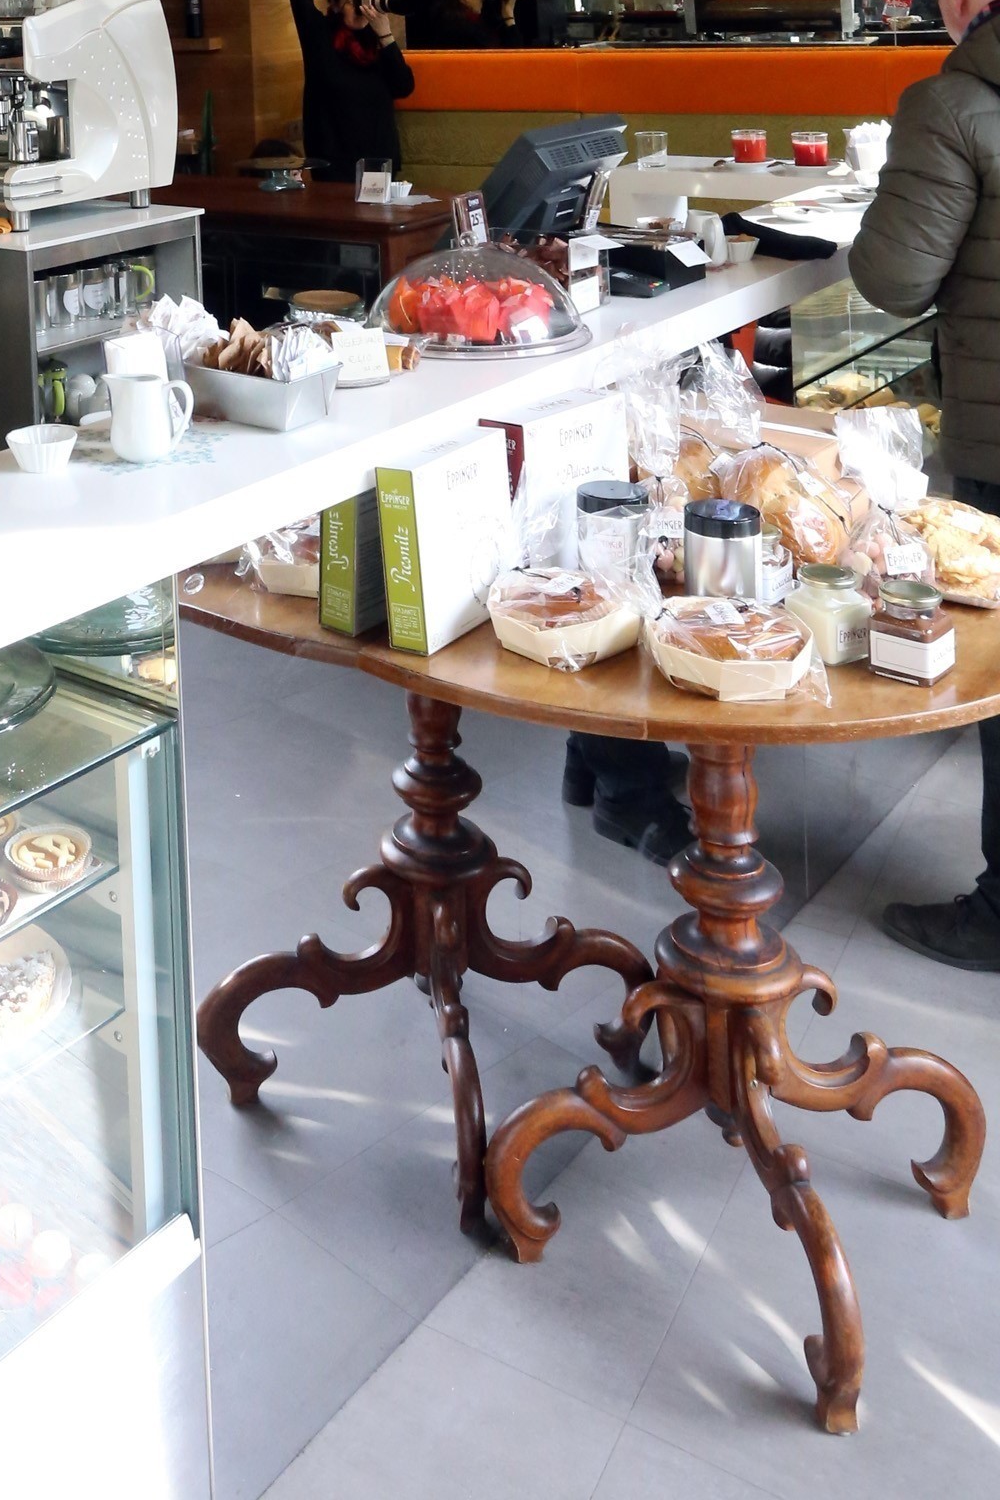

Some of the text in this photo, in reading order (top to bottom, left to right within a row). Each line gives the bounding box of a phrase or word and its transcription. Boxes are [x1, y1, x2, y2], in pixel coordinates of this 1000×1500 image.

[559, 422, 593, 447] EPPINGER
[446, 462, 479, 491] EPPINGER
[380, 490, 410, 506] EPPINGER
[390, 524, 416, 592] Presnitz
